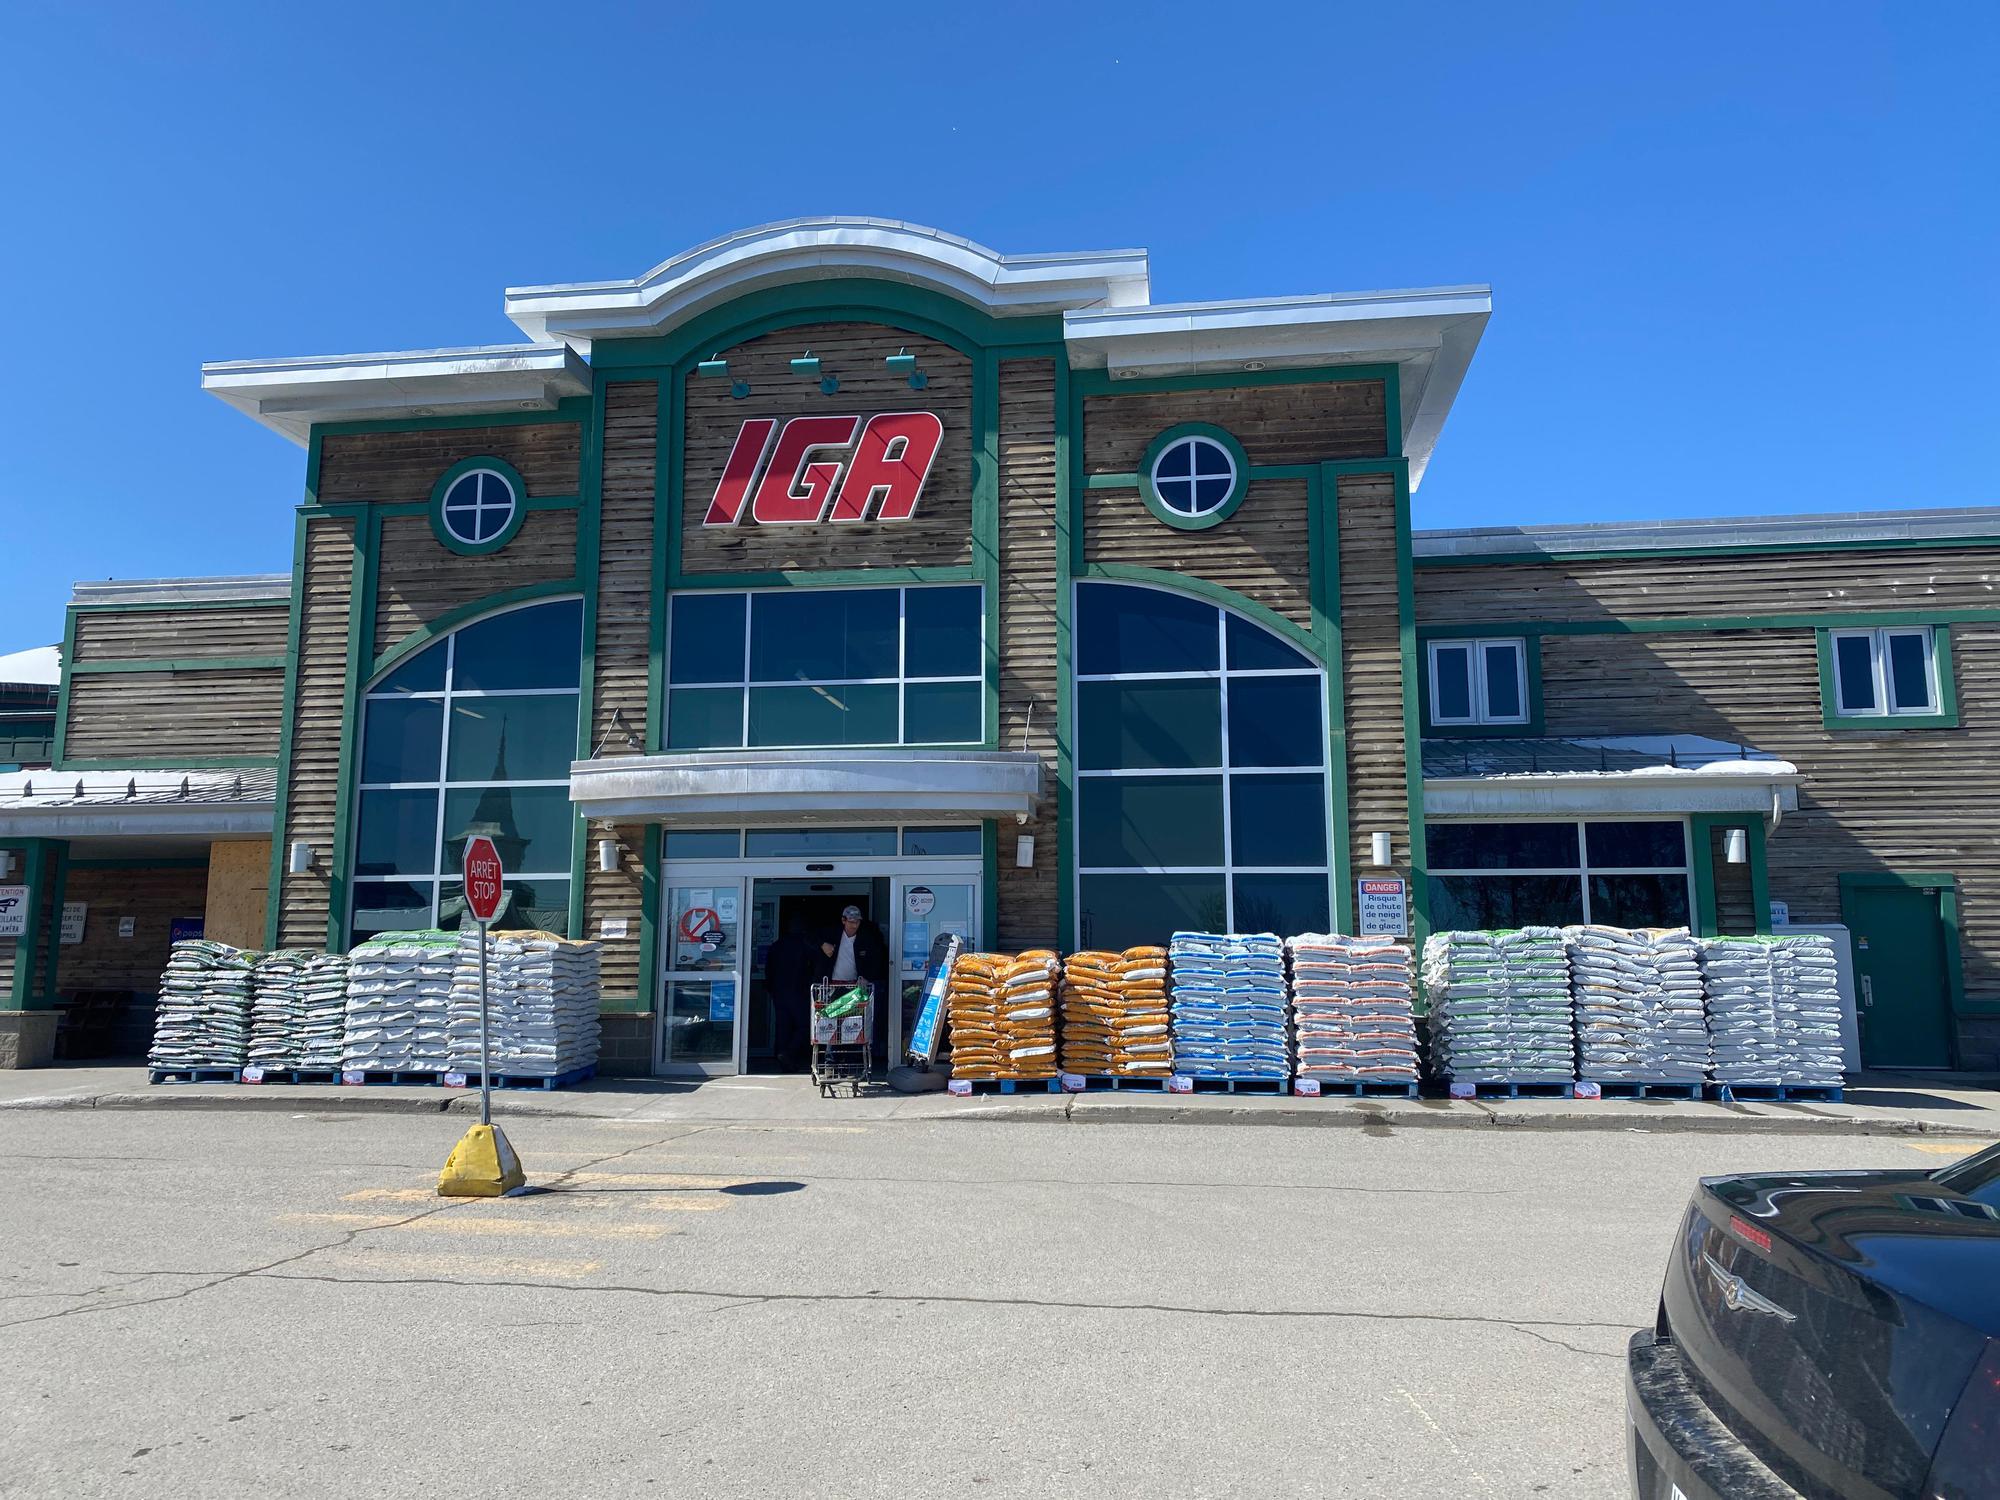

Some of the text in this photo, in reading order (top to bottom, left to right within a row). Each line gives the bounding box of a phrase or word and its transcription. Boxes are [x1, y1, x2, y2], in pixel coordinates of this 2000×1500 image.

[702, 411, 944, 528] IGA
[470, 858, 498, 880] ARRÊT
[473, 881, 496, 900] STOP
[1378, 911, 1400, 919] neige
[182, 929, 203, 939] peps
